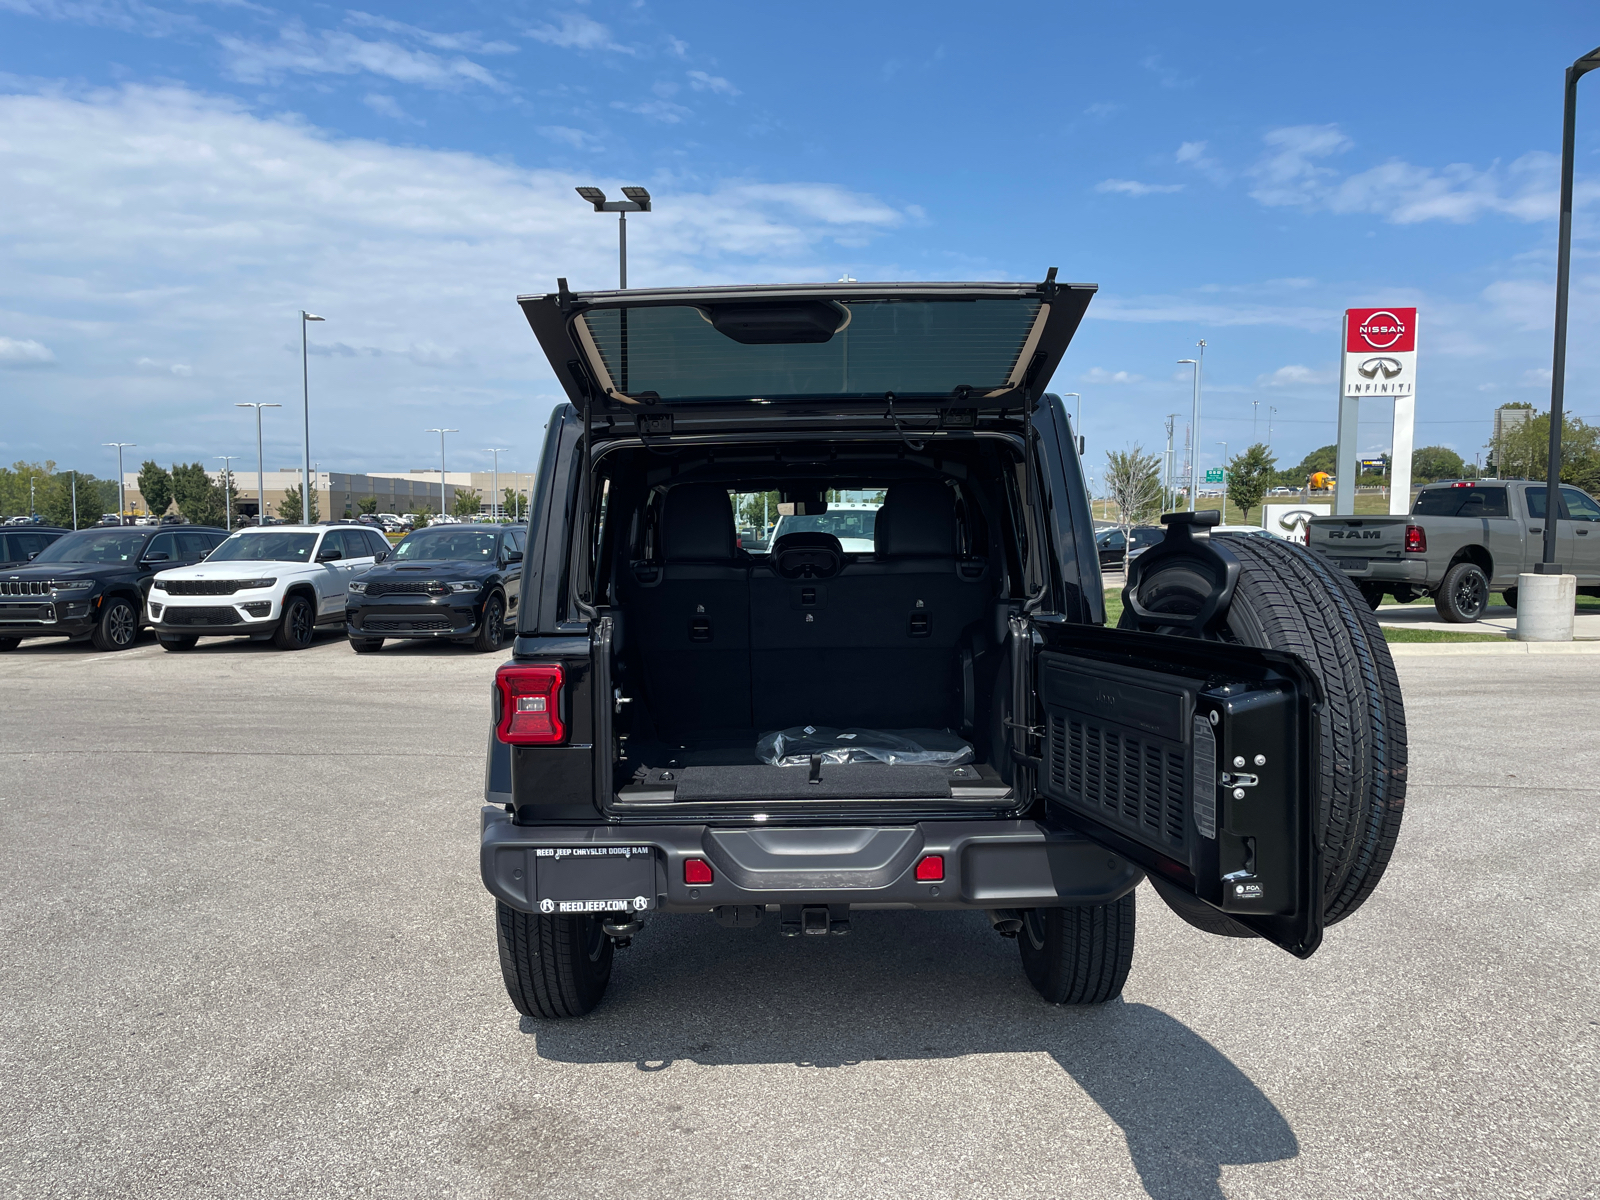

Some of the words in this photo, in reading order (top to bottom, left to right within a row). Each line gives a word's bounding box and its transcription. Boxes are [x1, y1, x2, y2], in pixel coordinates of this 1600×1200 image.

[1347, 383, 1411, 393] INFINITI
[1328, 530, 1381, 539] RAM
[555, 848, 571, 856] JEEP
[573, 848, 607, 856] CHRYSLER
[609, 847, 631, 855] DODGE
[559, 901, 627, 912] REEDJEEP.COM
